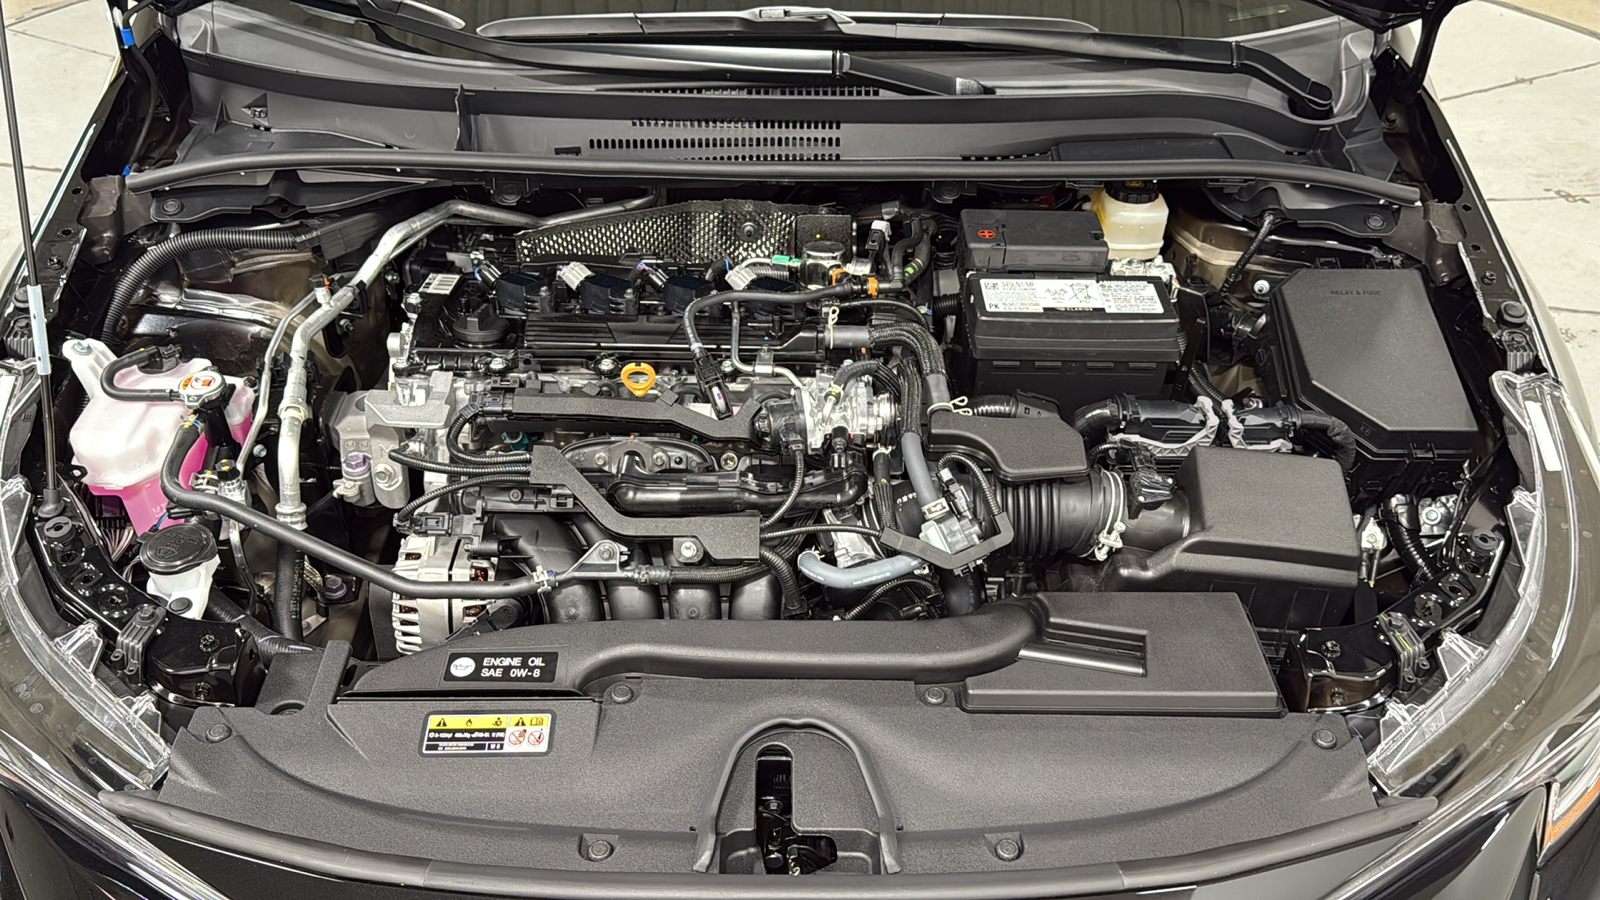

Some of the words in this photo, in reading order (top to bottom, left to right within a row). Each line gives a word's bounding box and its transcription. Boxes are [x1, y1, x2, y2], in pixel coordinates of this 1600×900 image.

[482, 657, 522, 667] ENGINE
[527, 657, 546, 667] OIL
[480, 668, 503, 677] SAE
[510, 668, 541, 678] 0W-8
